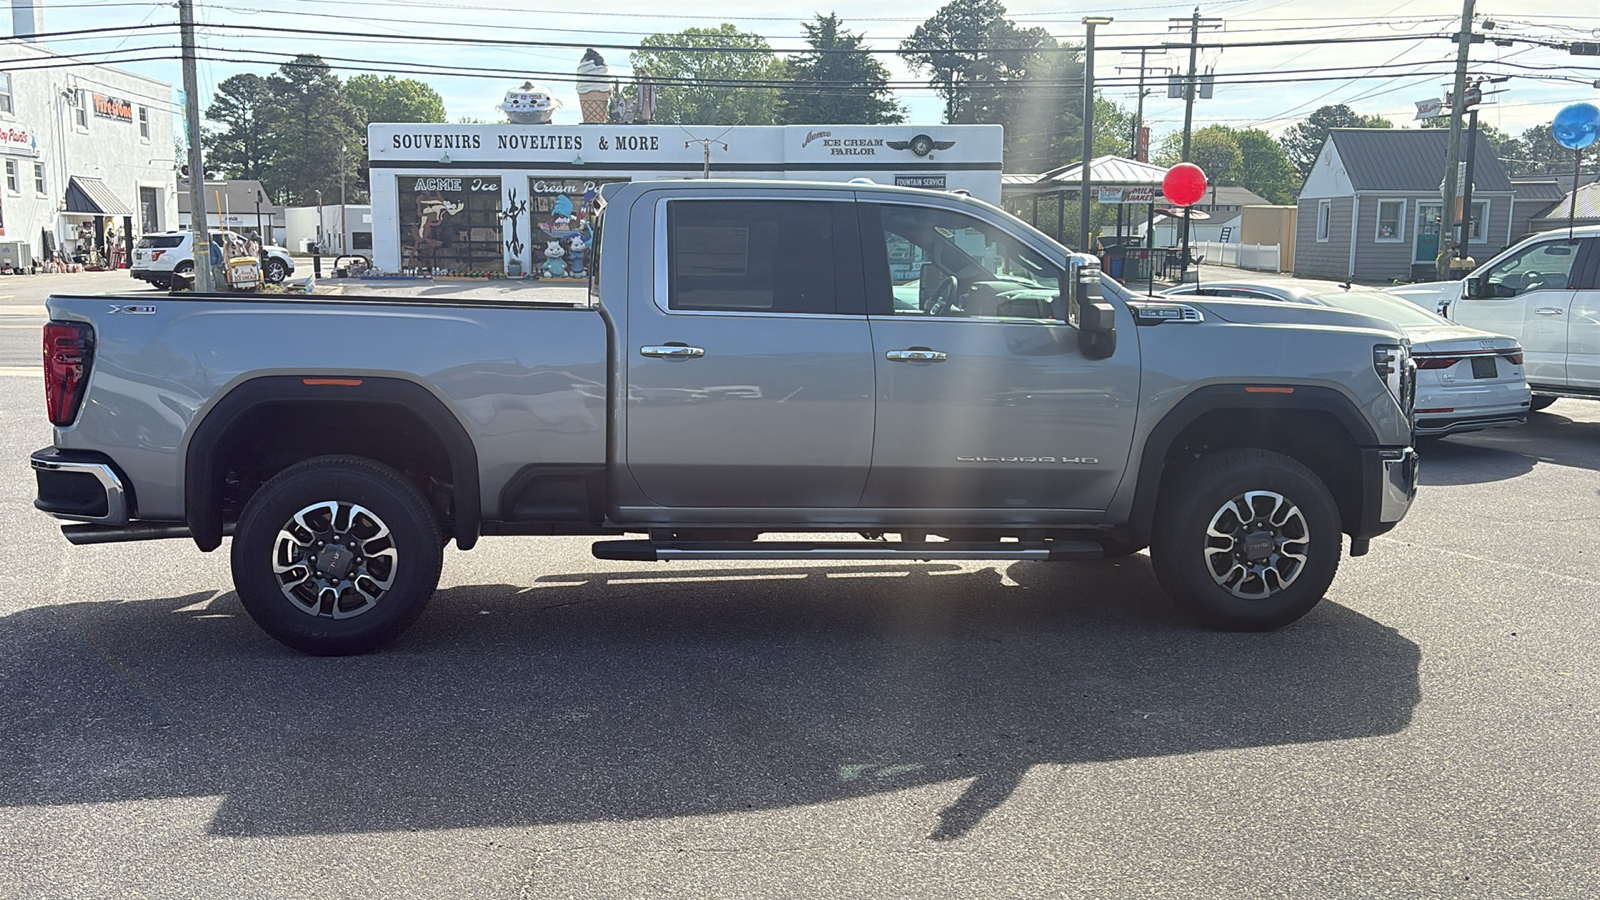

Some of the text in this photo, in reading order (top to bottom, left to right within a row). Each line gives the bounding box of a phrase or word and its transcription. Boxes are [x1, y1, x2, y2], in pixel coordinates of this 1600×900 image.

[93, 94, 132, 119] Firestone
[0, 128, 28, 144] oy Paints
[393, 134, 659, 150] SOUVENIRS NOVELTIES & MORE
[823, 139, 884, 147] ICE CREAM
[414, 178, 462, 191] ACME
[471, 178, 499, 191] Ice
[533, 181, 577, 193] Cream
[896, 178, 944, 186] FOUNTAIN SERVICE
[1132, 187, 1153, 195] MILK
